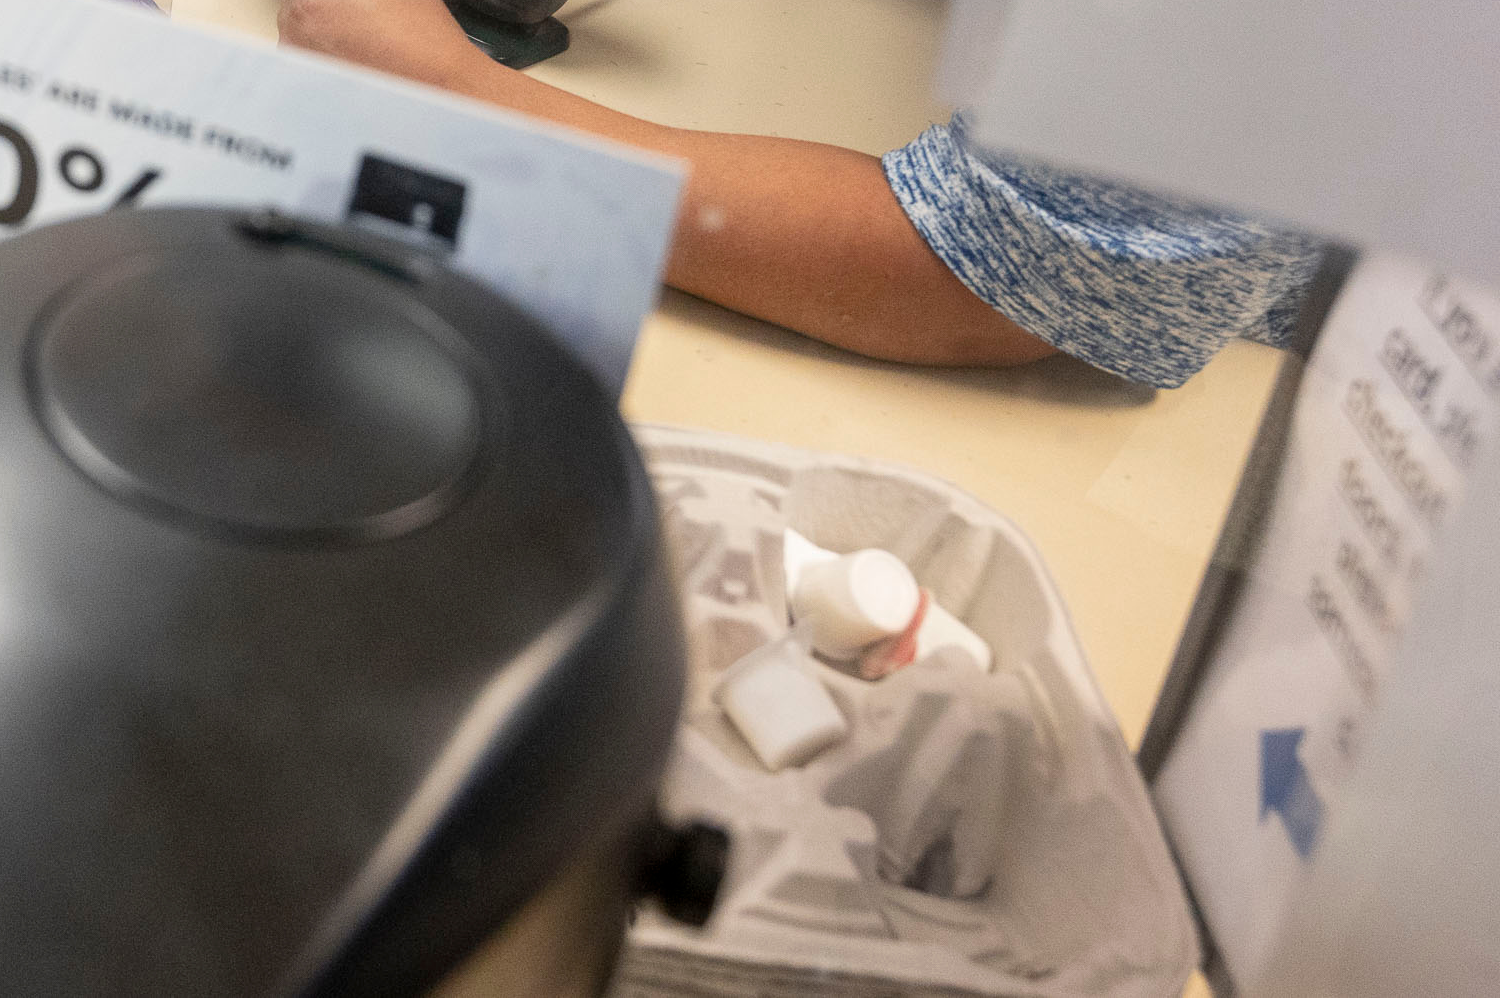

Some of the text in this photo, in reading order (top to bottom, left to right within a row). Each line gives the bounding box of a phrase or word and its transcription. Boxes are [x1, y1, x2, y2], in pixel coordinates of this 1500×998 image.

[44, 79, 100, 114] ARE
[108, 98, 194, 142] MADE
[204, 123, 296, 172] FROM
